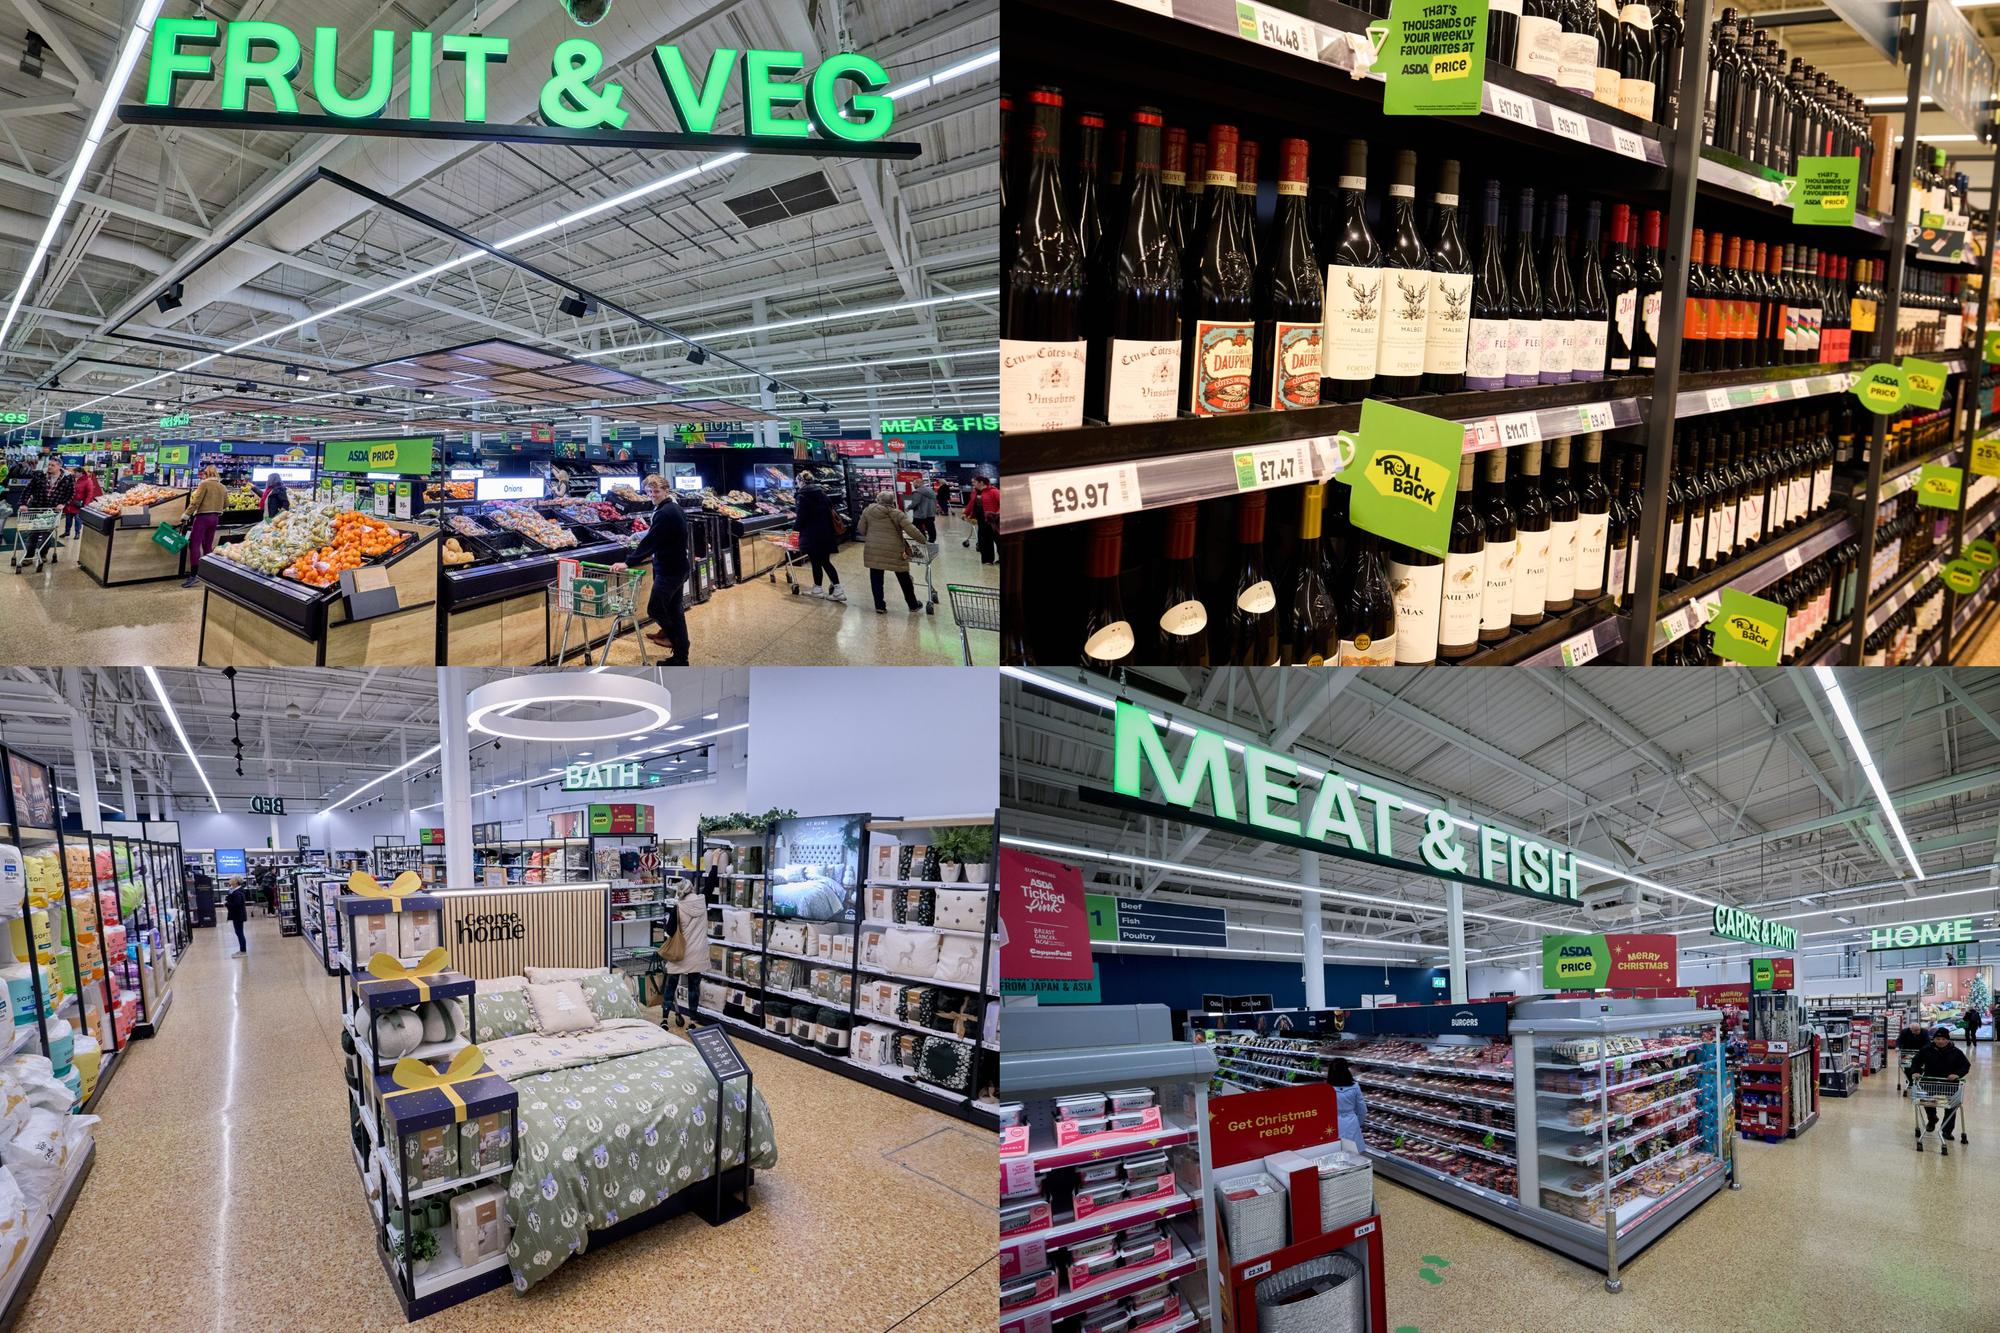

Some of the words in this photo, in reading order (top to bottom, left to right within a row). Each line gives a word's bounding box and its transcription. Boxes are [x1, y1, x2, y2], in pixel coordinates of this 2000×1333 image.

[1463, 16, 1477, 28] OF
[1262, 20, 1299, 51] £14.48
[1404, 32, 1430, 43] YOUR
[1401, 63, 1429, 75] ASDA
[146, 17, 509, 122] FRUIT
[540, 38, 628, 130] &
[654, 44, 894, 142] VEG
[1499, 97, 1523, 120] £17.97
[1872, 375, 1899, 387] ASDA
[881, 419, 936, 433] MEAT
[942, 418, 959, 431] &
[1505, 422, 1528, 440] £11.17
[348, 450, 369, 462] ASDA
[1260, 457, 1295, 481] £7.47
[1384, 462, 1422, 482] ROLL
[503, 484, 523, 493] Onions
[1051, 482, 1109, 514] £9.97
[1401, 607, 1424, 616] MAS
[566, 763, 640, 788] BATH
[1113, 700, 1404, 857] MEAT
[1419, 808, 1468, 875] &
[1479, 824, 1578, 899] FISH
[1030, 878, 1054, 890] ASDA
[1020, 885, 1065, 904] Tickled
[1121, 902, 1142, 910] Beef
[1090, 910, 1102, 926] 1
[1122, 917, 1141, 925] Fish
[456, 920, 525, 945] home
[1714, 904, 1760, 942] CARDS
[1761, 919, 1769, 943] &
[1770, 922, 1798, 950] PARTY
[1871, 919, 1973, 949] HOME
[1123, 931, 1156, 942] Poultry
[1559, 946, 1593, 957] ASDA
[1000, 982, 1026, 991] FROM
[1031, 981, 1059, 991] JAPAN
[1063, 982, 1071, 991] &
[1073, 982, 1092, 992] ASIA
[1228, 1119, 1252, 1132] Get
[1255, 1108, 1318, 1127] Christmas
[1259, 1124, 1295, 1139] ready
